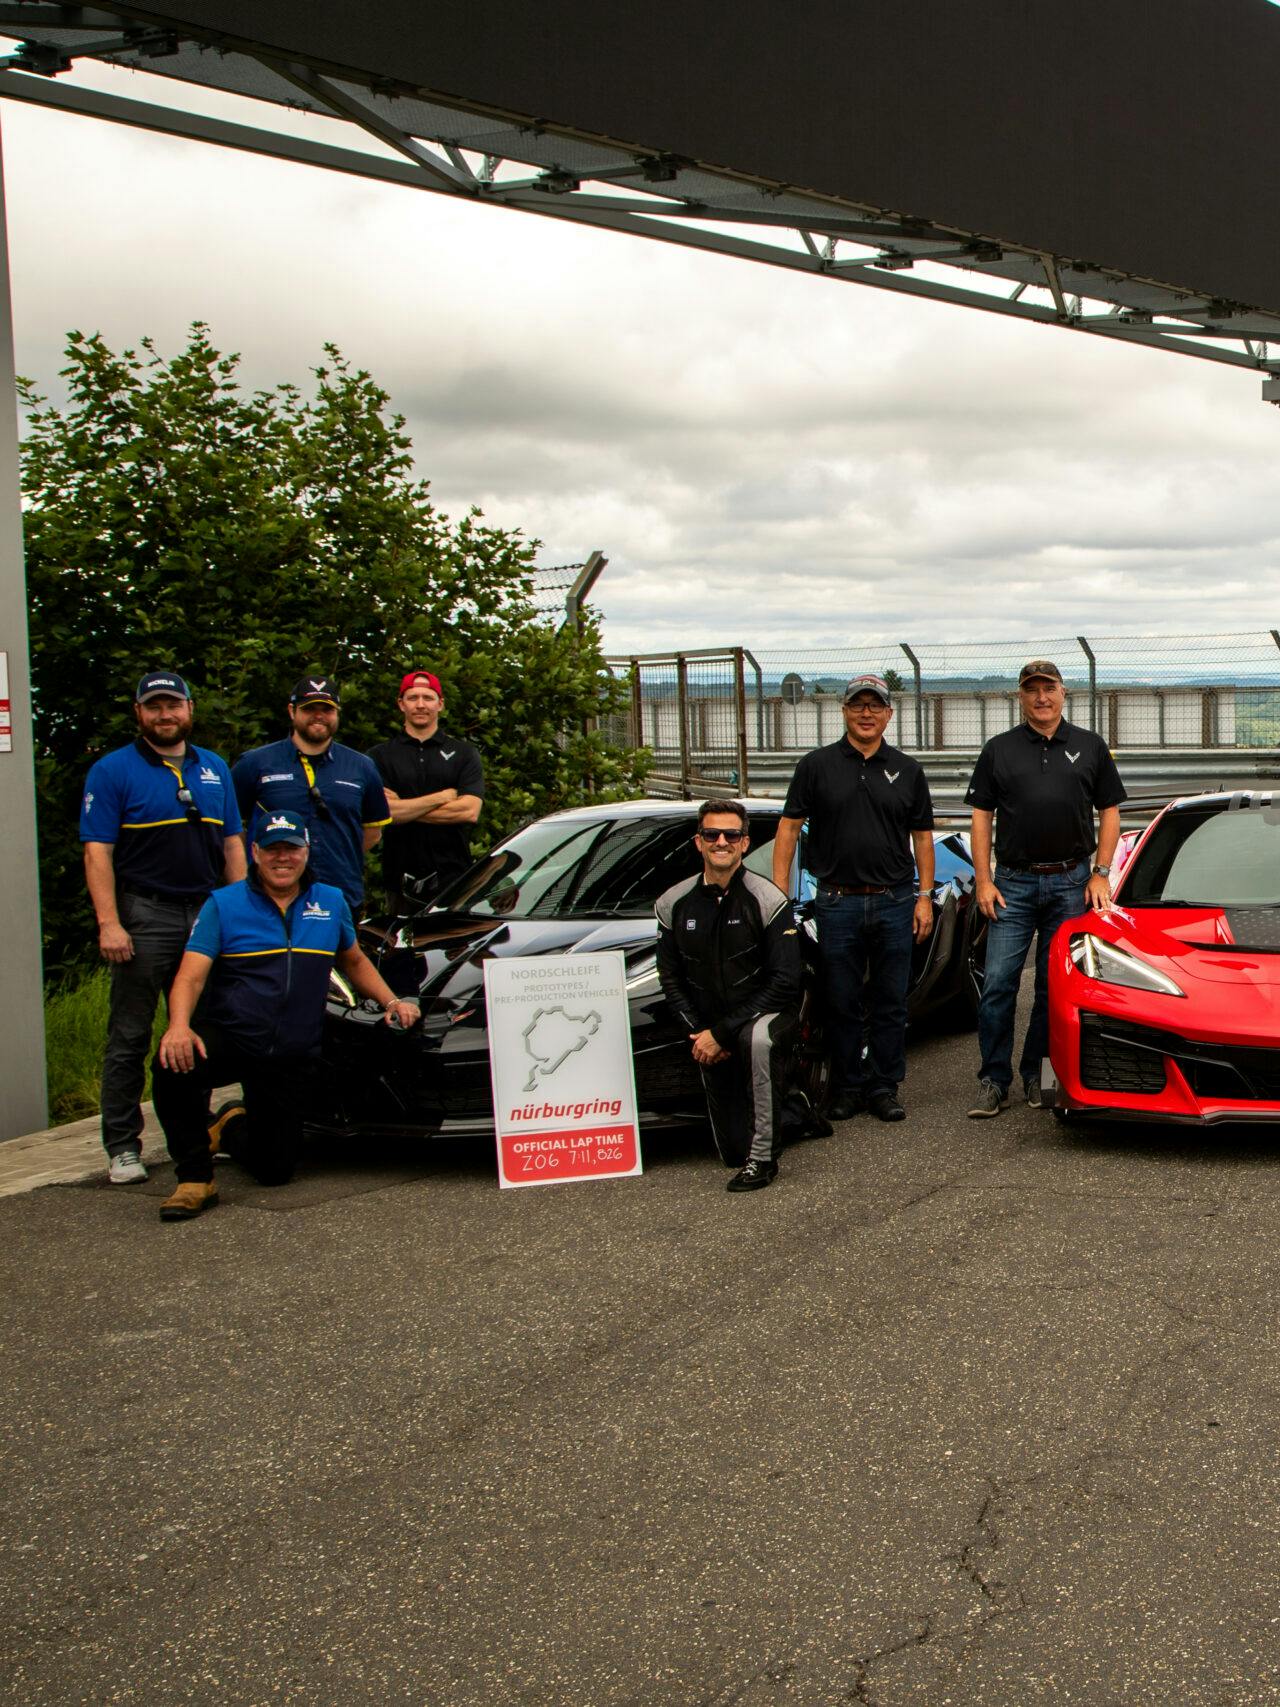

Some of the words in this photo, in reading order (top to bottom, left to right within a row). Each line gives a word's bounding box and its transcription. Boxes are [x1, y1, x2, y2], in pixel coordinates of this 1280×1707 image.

[511, 965, 601, 980] NORDSCHLEIFE
[524, 981, 584, 993] PROTOTYPES
[495, 991, 576, 1004] PRE-PRODUCTION
[578, 988, 620, 998] VEHICLES
[510, 1098, 622, 1121] nürburgring
[513, 1141, 568, 1153] OFFICIAL
[570, 1136, 593, 1148] LAP
[595, 1133, 624, 1145] TIME
